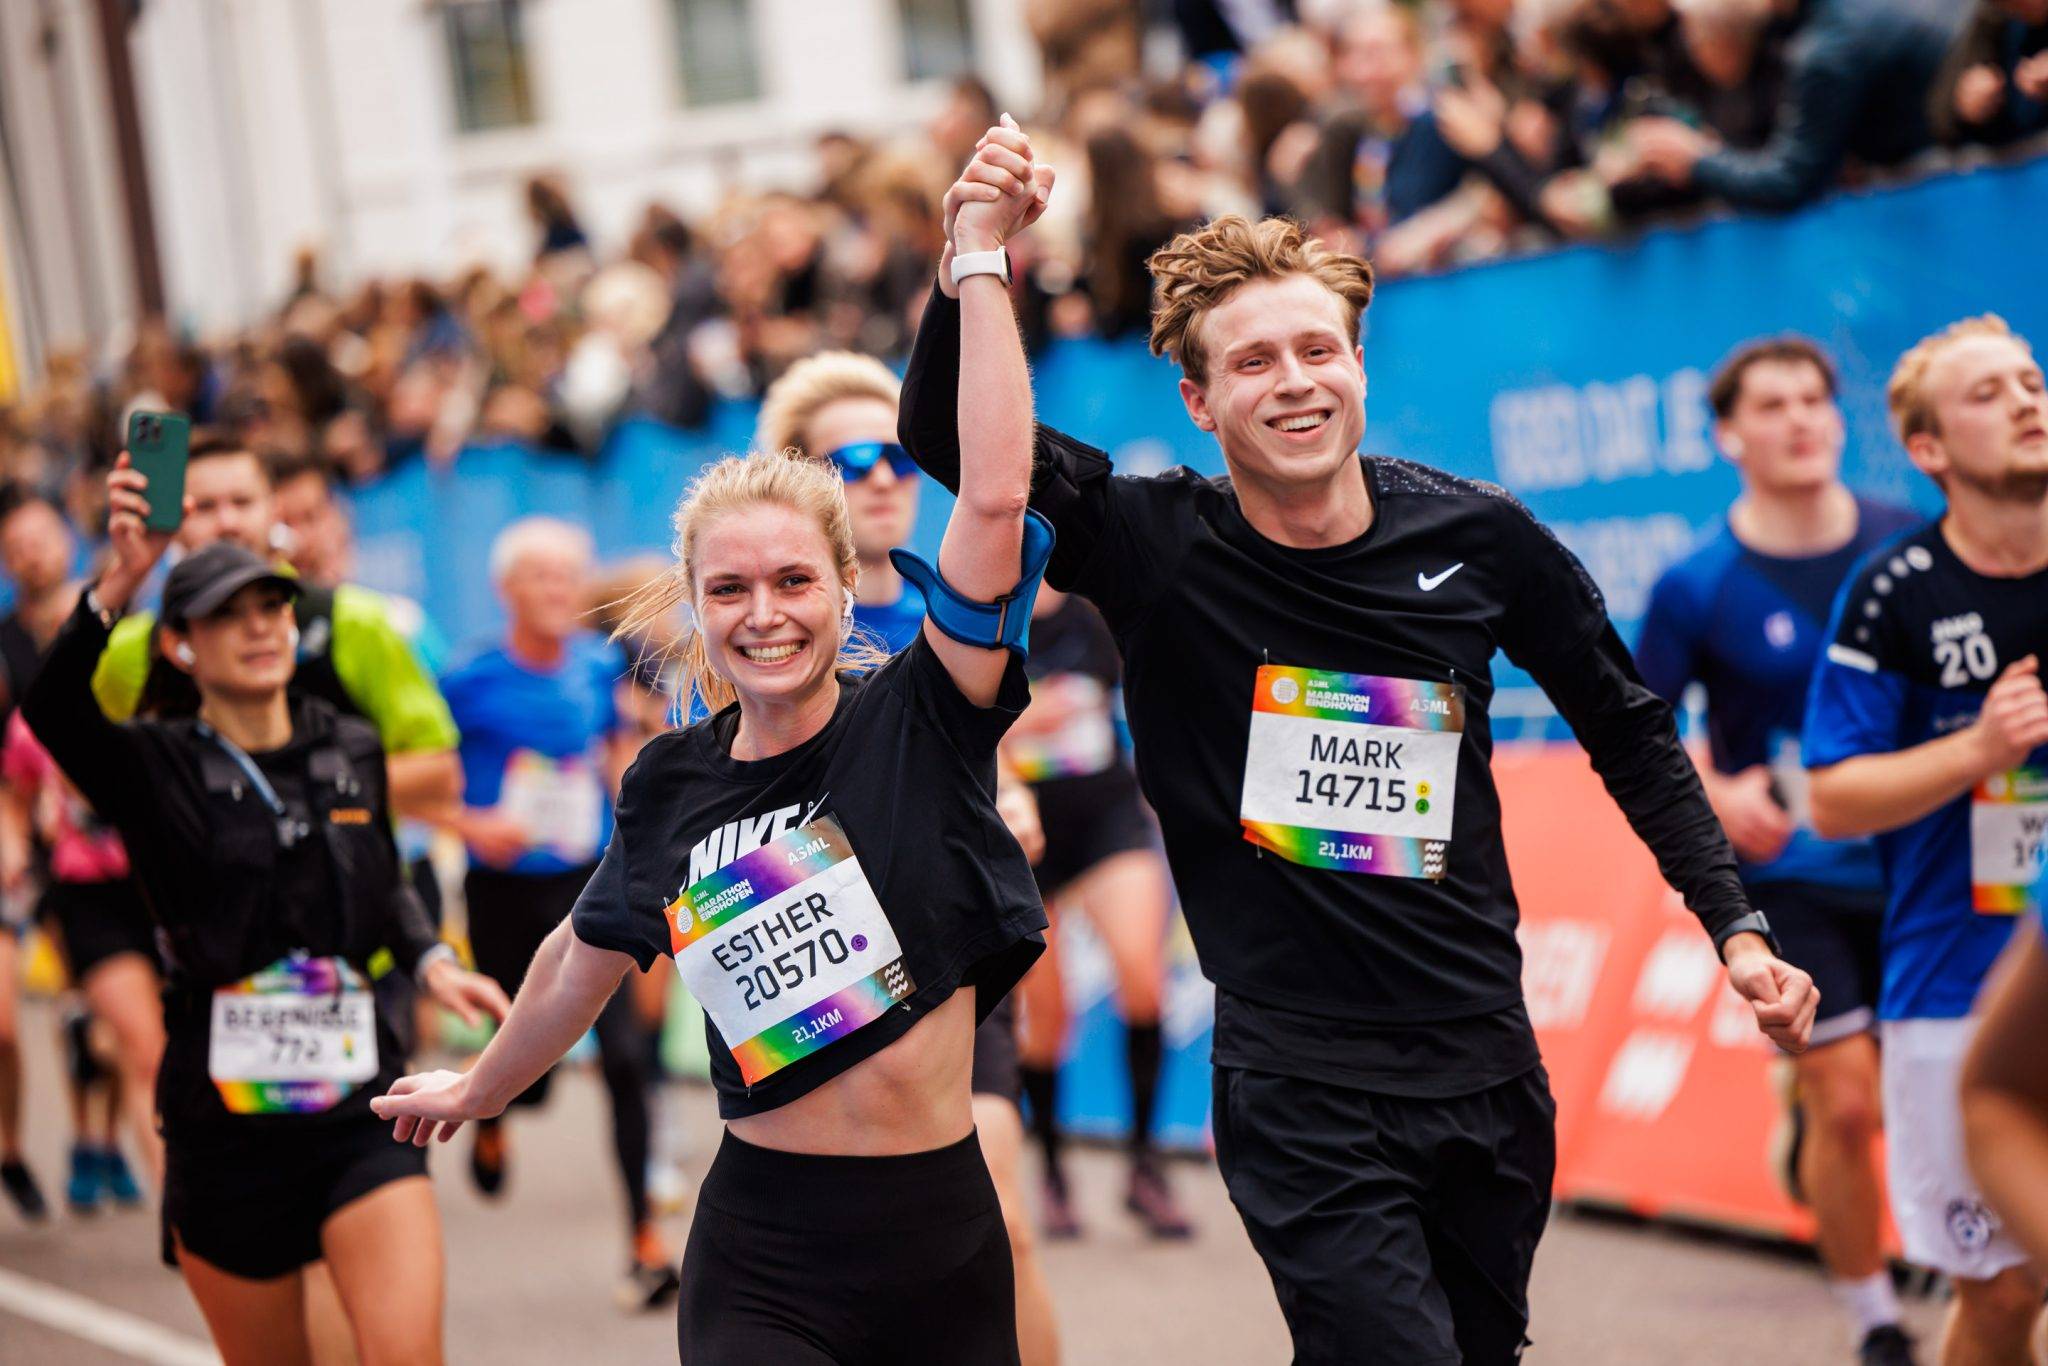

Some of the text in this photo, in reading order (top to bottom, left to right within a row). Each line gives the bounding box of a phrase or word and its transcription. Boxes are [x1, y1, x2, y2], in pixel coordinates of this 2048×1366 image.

[1934, 633, 1998, 688] 20
[1305, 699, 1369, 713] EINDHOVEN
[1306, 690, 1370, 703] MARATHON
[1410, 699, 1450, 715] ASML
[1310, 734, 1403, 770] MARK
[1295, 770, 1406, 813] 14715
[787, 837, 830, 866] ASML
[1319, 841, 1373, 861] 21,1KM
[693, 890, 709, 904] ASML
[696, 879, 750, 914] MARATHON
[700, 886, 754, 922] EINDHOVEN
[711, 892, 834, 972] ESTHER
[736, 928, 849, 1011] 20570
[792, 1008, 843, 1044] 21,1KM
